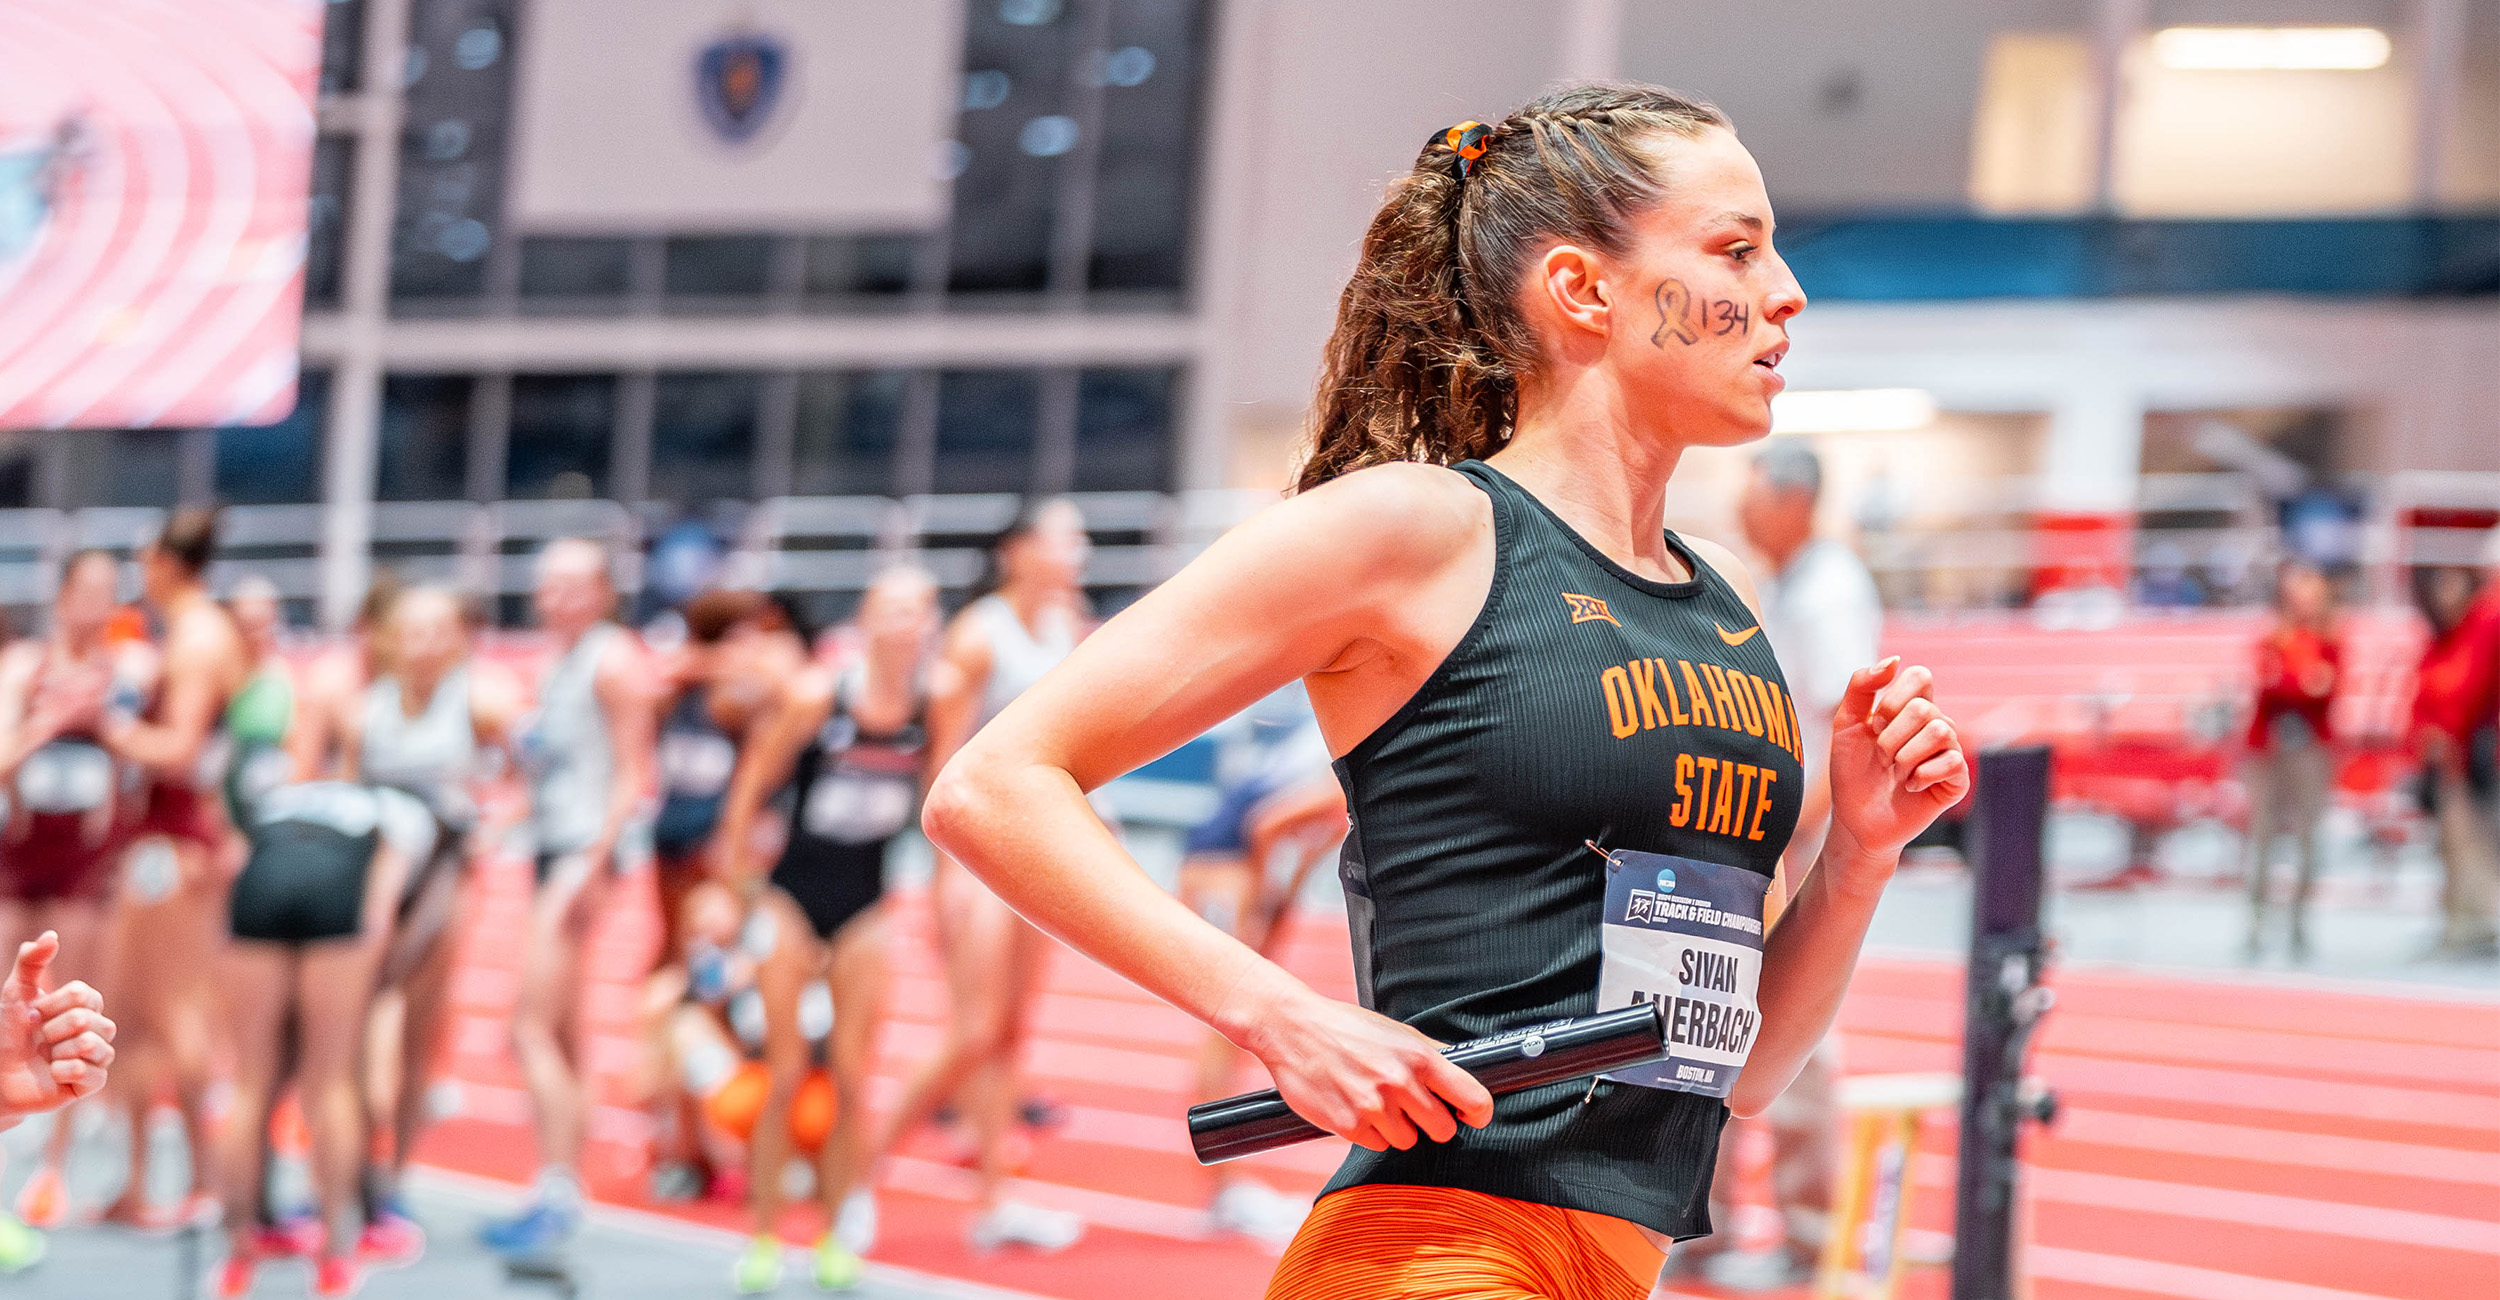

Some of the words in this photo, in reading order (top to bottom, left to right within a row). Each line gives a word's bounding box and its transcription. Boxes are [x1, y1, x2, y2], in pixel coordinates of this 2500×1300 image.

[1701, 298, 1749, 336] 134
[1600, 657, 1804, 767] OKLAHOMA
[1669, 752, 1777, 841] STATE
[1654, 901, 1689, 920] TRACK
[1695, 908, 1722, 926] FIELD
[1678, 948, 1738, 994] SIVAN
